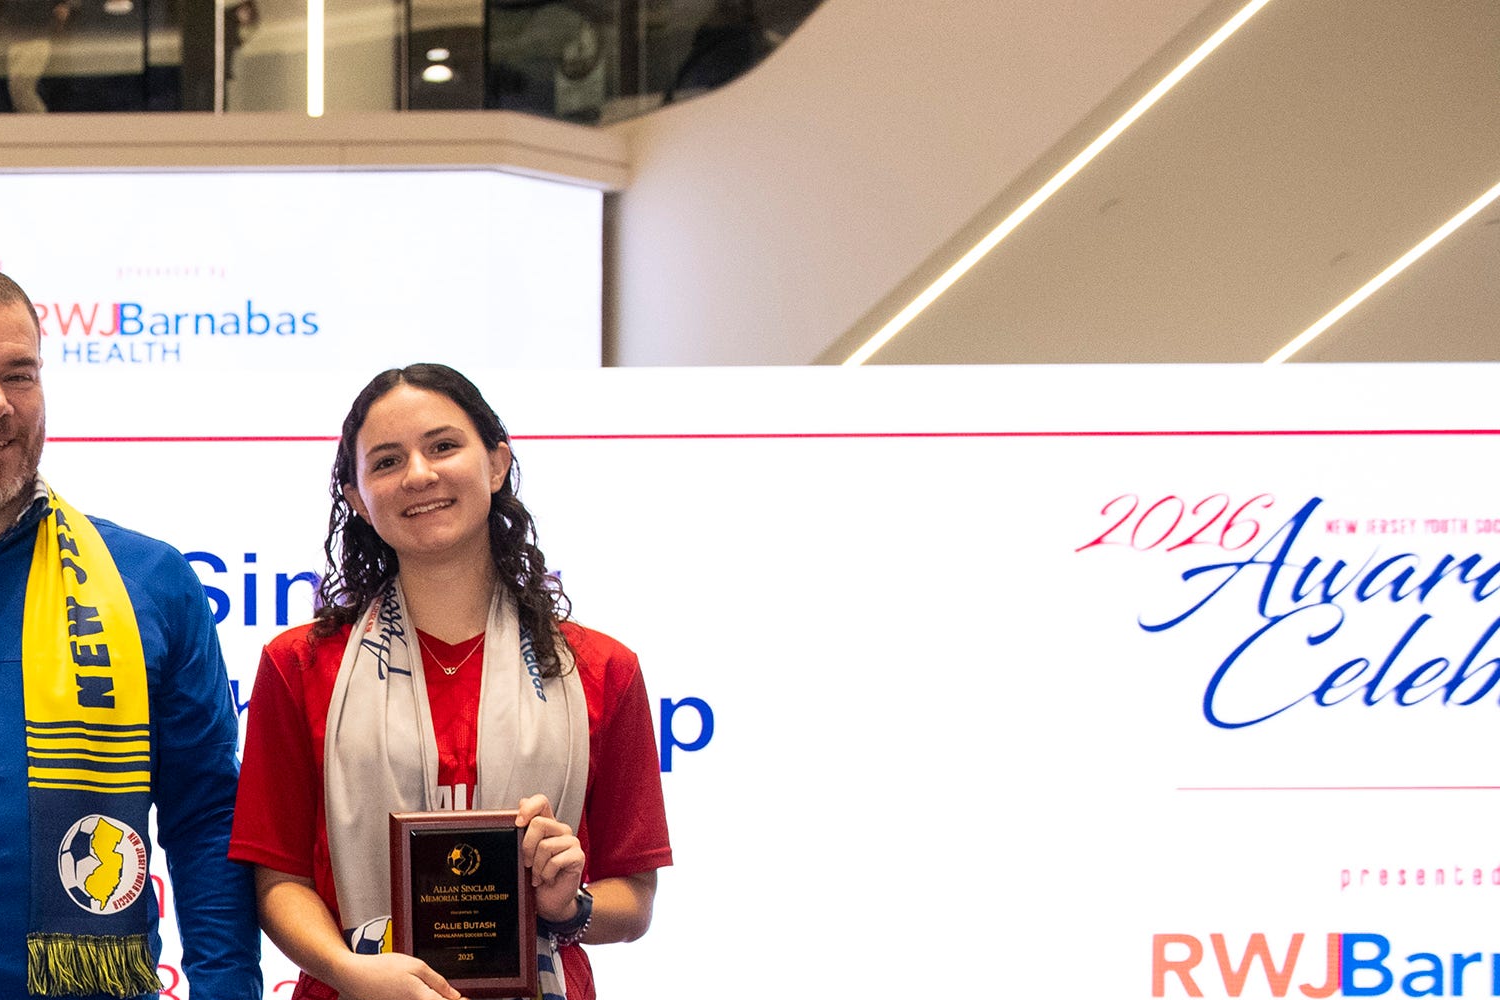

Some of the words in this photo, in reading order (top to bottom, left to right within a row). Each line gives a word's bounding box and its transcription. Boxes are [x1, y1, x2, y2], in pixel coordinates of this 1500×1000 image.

[62, 341, 181, 364] HEALTH
[1074, 493, 1275, 553] 2026
[66, 596, 116, 710] NEW
[127, 832, 141, 847] NEW
[433, 885, 459, 893] ALLAN
[460, 884, 496, 893] SINCLAIR
[112, 889, 136, 910] SOCCER
[420, 895, 460, 903] MEMORIAL
[460, 893, 509, 901] SCHOLARSHIP
[434, 922, 462, 930] CALLIE
[463, 921, 496, 929] BUTASH
[458, 953, 474, 961] 2025
[1151, 932, 1500, 999] RWJBar
